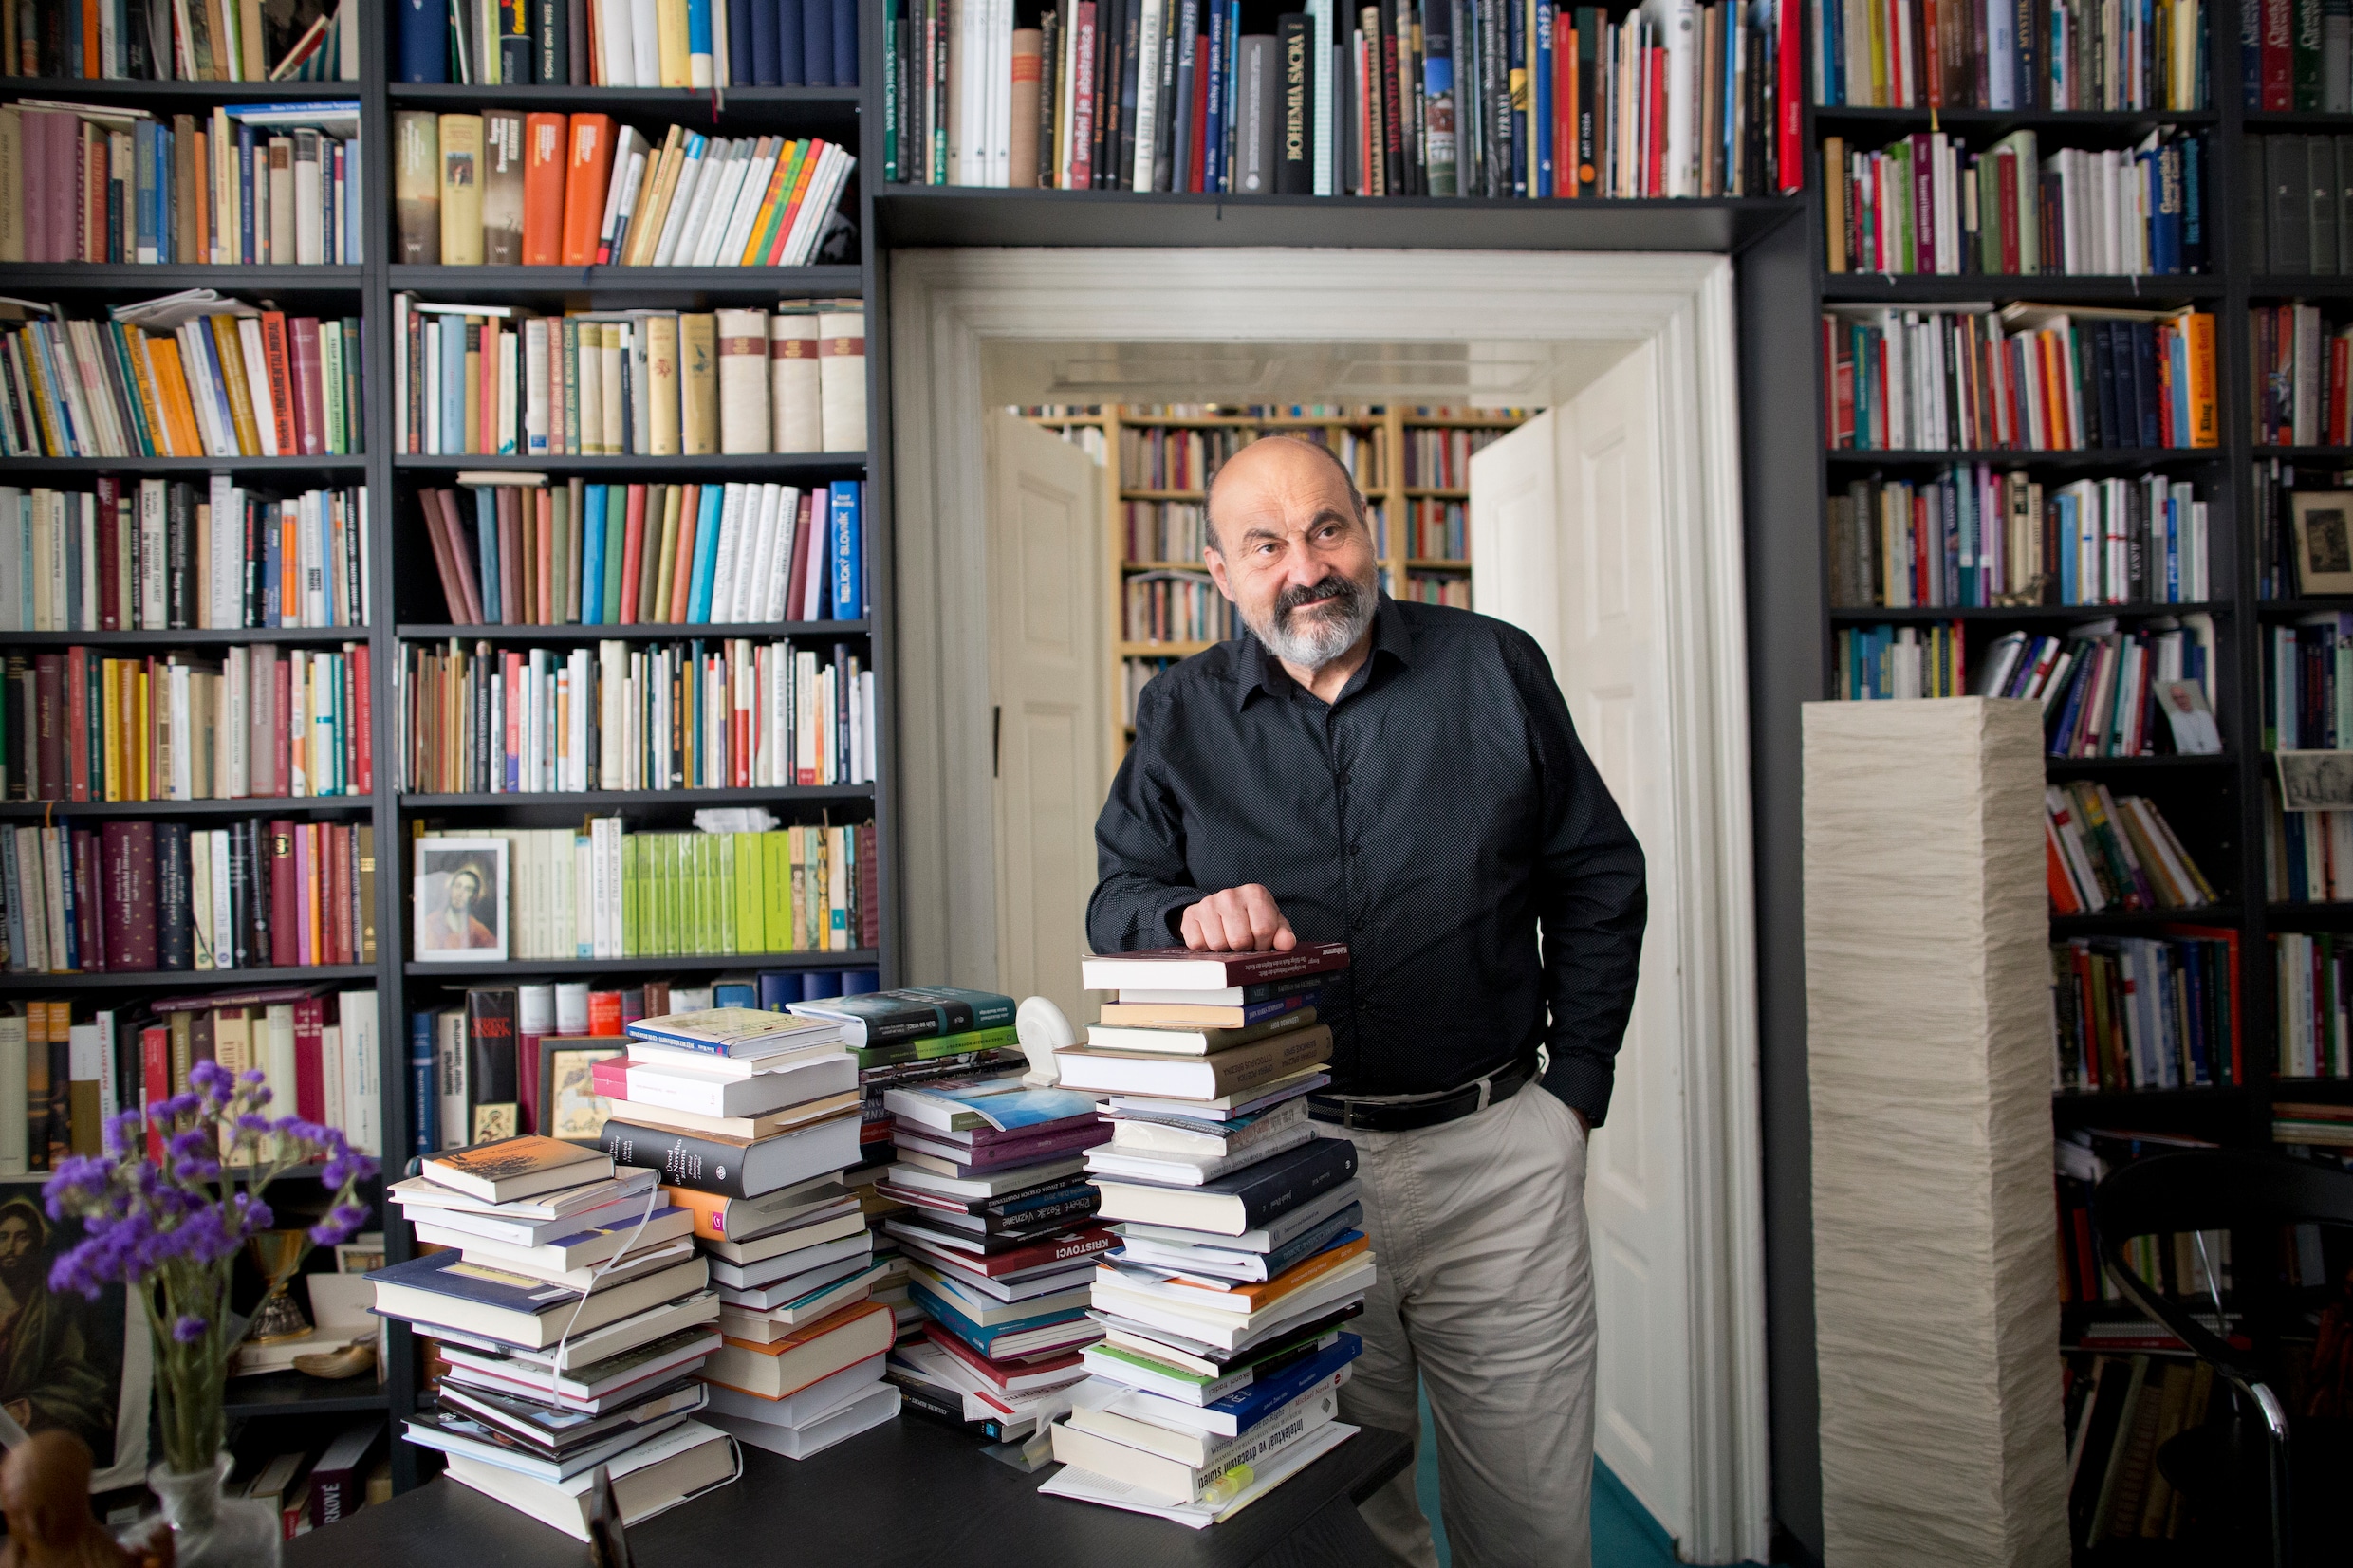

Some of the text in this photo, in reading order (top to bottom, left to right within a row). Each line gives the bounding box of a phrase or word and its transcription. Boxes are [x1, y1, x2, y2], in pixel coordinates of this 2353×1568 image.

[544, 3, 554, 80] SEIN UND ETHOS
[1287, 33, 1305, 84] SACRA
[1076, 23, 1094, 161] umění je abstrakce
[1384, 33, 1401, 154] MEMENTO MORI
[1140, 104, 1154, 140] BIBLE
[1285, 84, 1305, 161] BOHEMIA
[548, 322, 561, 348] ČESKÉ
[562, 323, 574, 349] ČESKÉ
[270, 320, 289, 418] FUNDAMENTALMORAL
[549, 349, 563, 384] KORUNY
[563, 349, 576, 385] KORUNY
[550, 384, 564, 408] ZEMÍ
[564, 386, 576, 410] ZEMÍ
[143, 491, 152, 519] TRACY
[142, 531, 151, 541] IN
[839, 511, 851, 604] BIBLICKÝ SLOVNÍK
[42, 712, 52, 739] Filosofie
[120, 834, 132, 925] Česká katolická literatura
[167, 836, 178, 926] Česká katolická literatura
[1322, 946, 1347, 956] Kohlhammer
[907, 1020, 936, 1032] Bůh se vrací:
[1269, 1016, 1300, 1030] LEONARDO BOFF
[973, 1038, 991, 1046] PRINZIP
[101, 1042, 110, 1091] PAPEŽOVI
[1257, 1063, 1273, 1074] OPERA
[673, 1138, 683, 1186] do Nového
[1020, 1188, 1042, 1200] ČESKÝCH
[1002, 1210, 1035, 1228] Vyznanie
[1036, 1203, 1061, 1219] Bezák
[1056, 1238, 1109, 1259] KRISTOVCI
[911, 1397, 947, 1415] CULTURE REPORT
[1003, 1386, 1050, 1404] Segens
[1295, 1391, 1315, 1407] Michael
[1315, 1382, 1331, 1395] Novak
[659, 1430, 700, 1448] Jonathan
[1210, 1438, 1233, 1455] Writing
[1250, 1421, 1263, 1434] Left
[1269, 1409, 1285, 1424] Right
[1269, 1418, 1304, 1450] Intelektuál
[1258, 1441, 1269, 1453] ve
